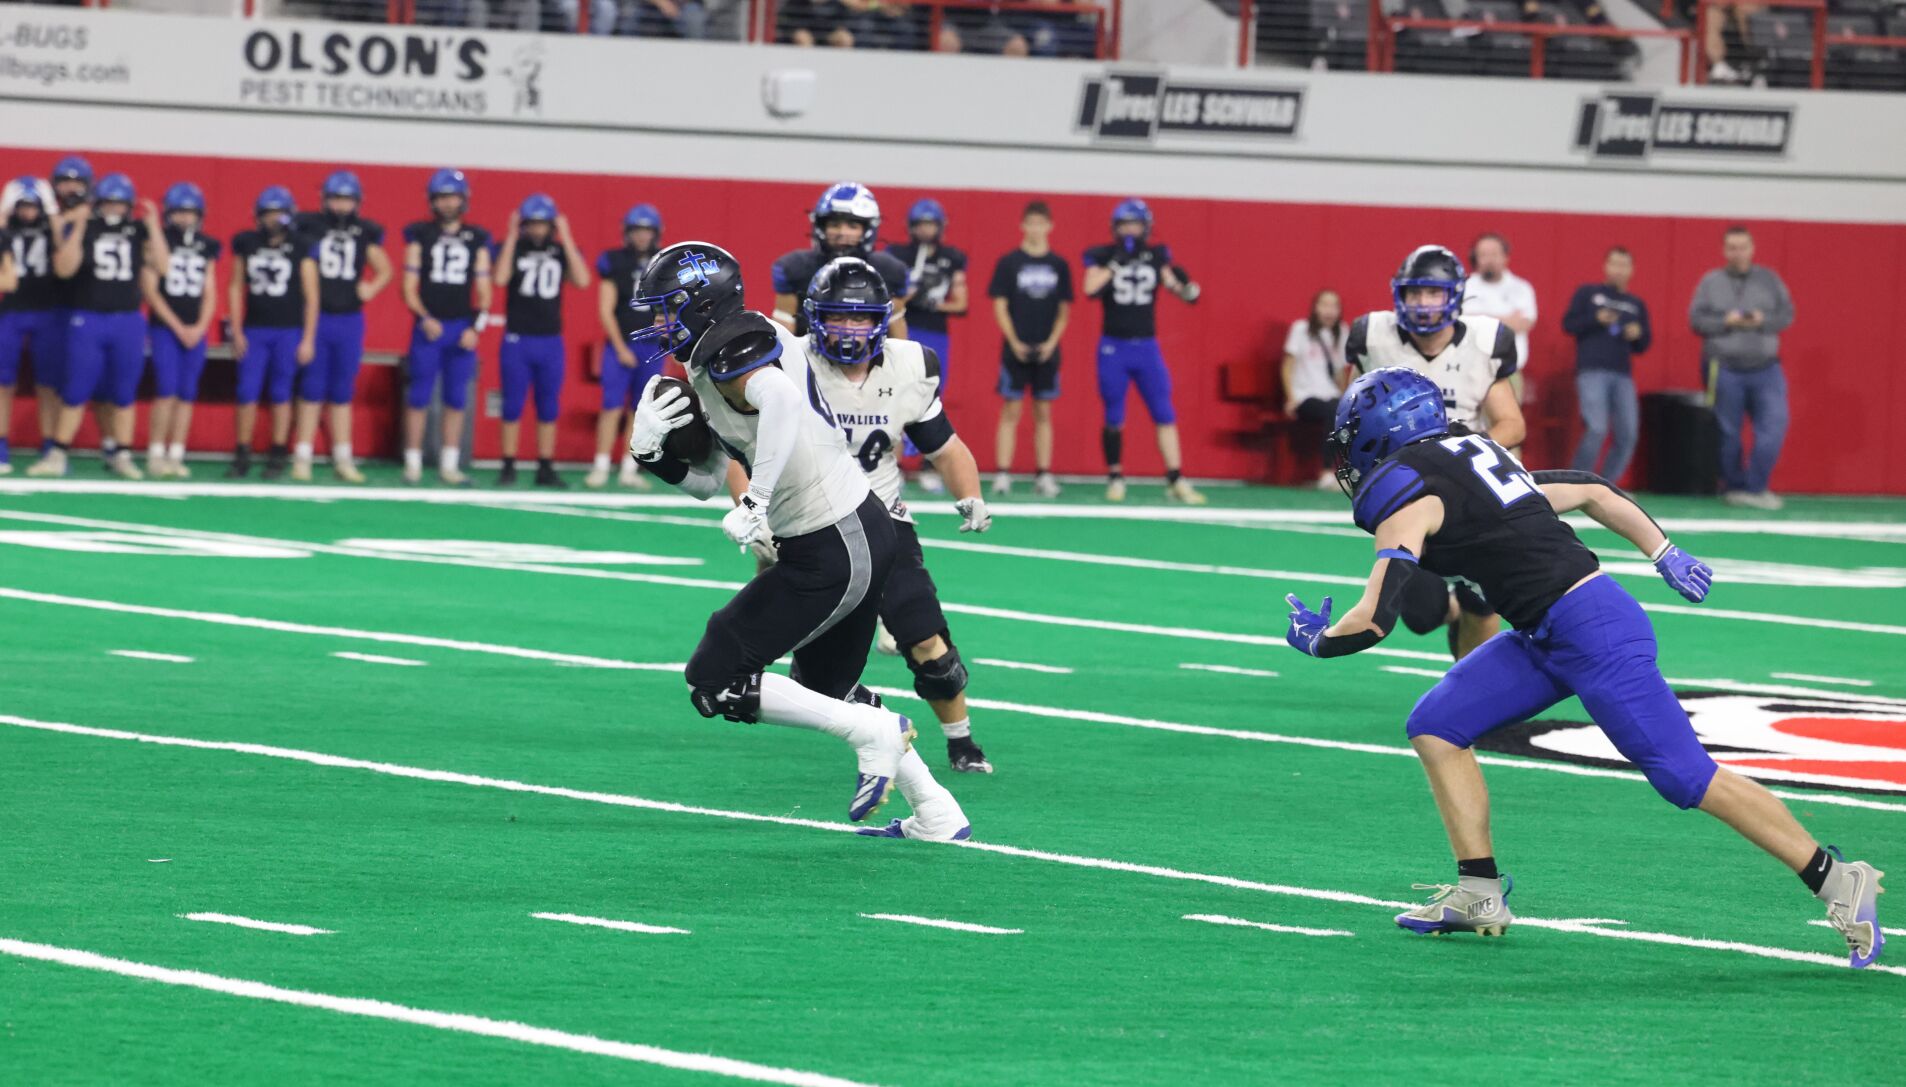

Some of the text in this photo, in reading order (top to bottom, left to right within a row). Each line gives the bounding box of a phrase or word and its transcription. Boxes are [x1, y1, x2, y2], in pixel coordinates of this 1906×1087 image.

[244, 30, 489, 80] OLSON'S
[240, 78, 488, 114] PEST TECHNICIANS
[1162, 91, 1200, 124] LES
[1202, 92, 1298, 128] SCHWAB
[1657, 112, 1693, 143] LES
[1695, 112, 1788, 147] SCHWAB
[12, 236, 48, 277] 14
[93, 238, 133, 281] 51
[165, 255, 207, 298] 65
[247, 254, 292, 297] 53
[319, 236, 356, 280] 61
[430, 241, 470, 285] 12
[517, 256, 562, 299] 70
[1112, 264, 1156, 305] 52
[837, 413, 889, 426] AVALIERS
[1466, 896, 1493, 921] NIKE
